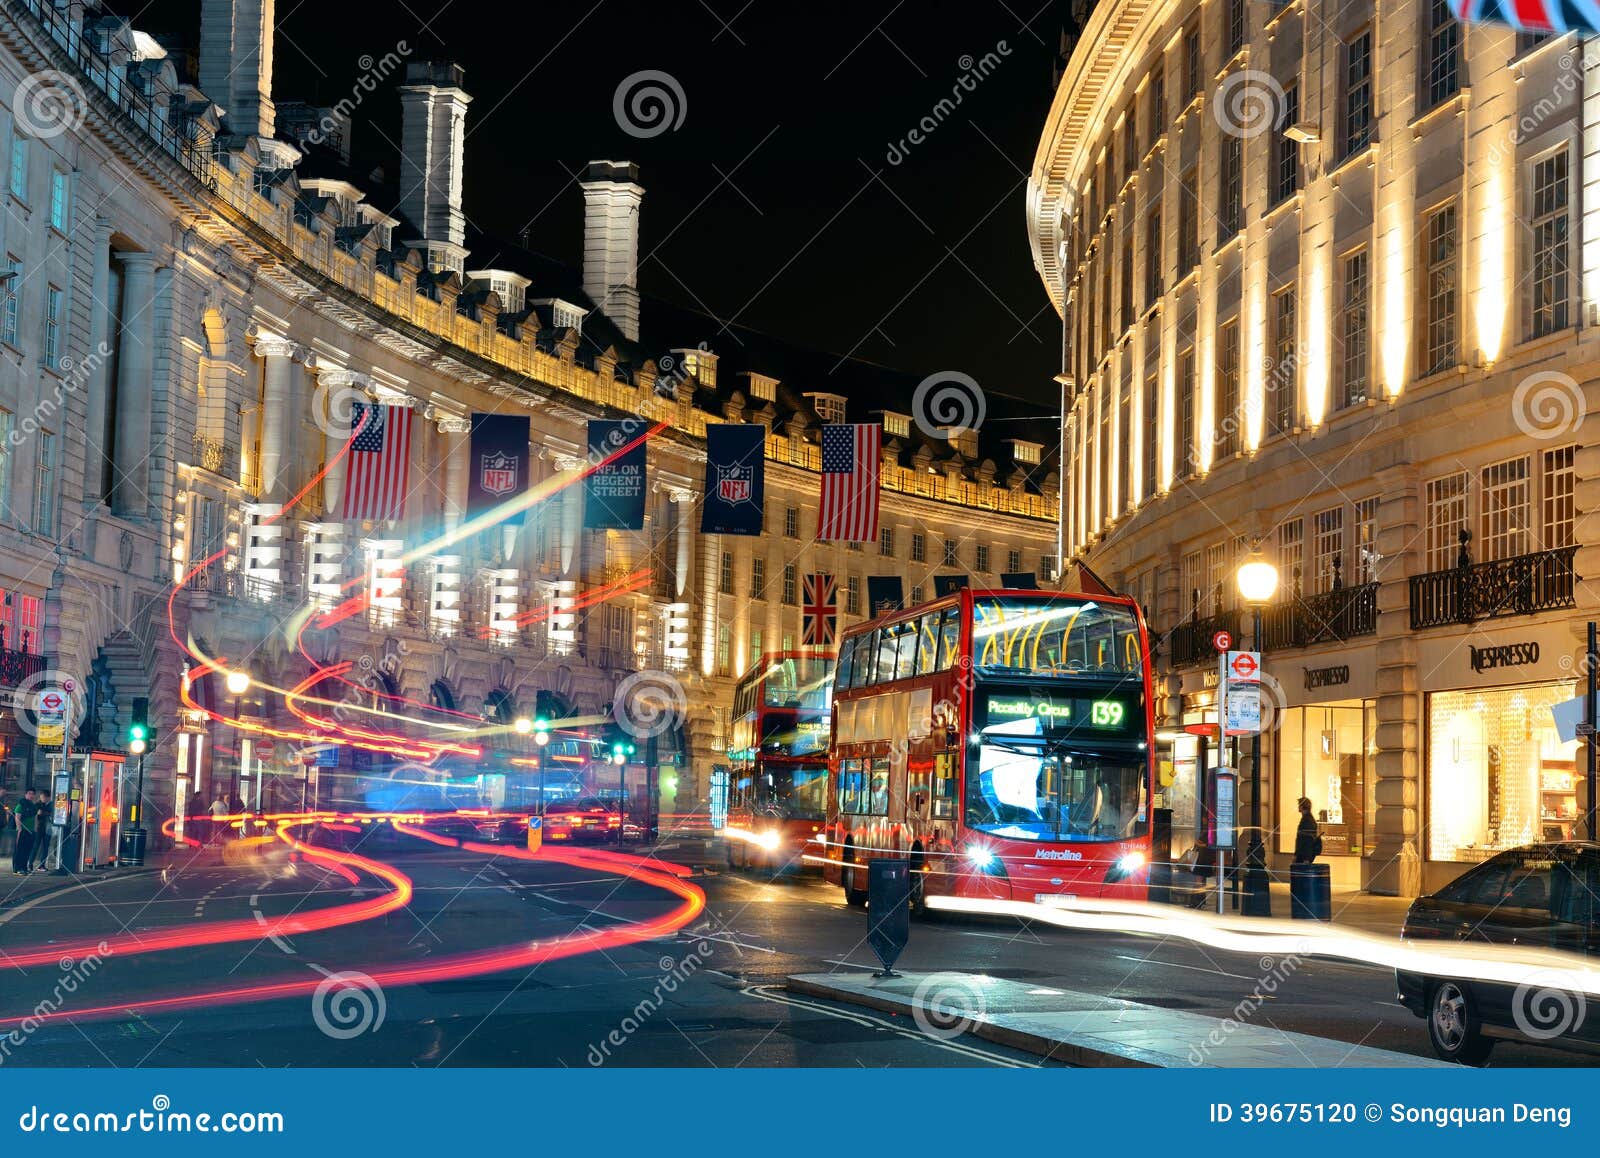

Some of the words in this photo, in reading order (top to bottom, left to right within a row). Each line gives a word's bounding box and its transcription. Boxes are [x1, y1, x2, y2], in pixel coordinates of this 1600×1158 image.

[596, 465, 619, 475] NFL
[621, 465, 639, 475] ON
[485, 470, 513, 490] NFL
[592, 475, 642, 486] REGENT
[593, 487, 641, 497] STREET
[721, 480, 748, 500] NFL
[1216, 634, 1229, 649] G
[1468, 641, 1540, 674] NESPRESSO
[1302, 665, 1350, 692] NESPRESSO
[988, 700, 1035, 717] Piccadilly
[1037, 702, 1071, 717] Circus
[1091, 700, 1124, 725] 139
[1035, 849, 1082, 860] Metroline
